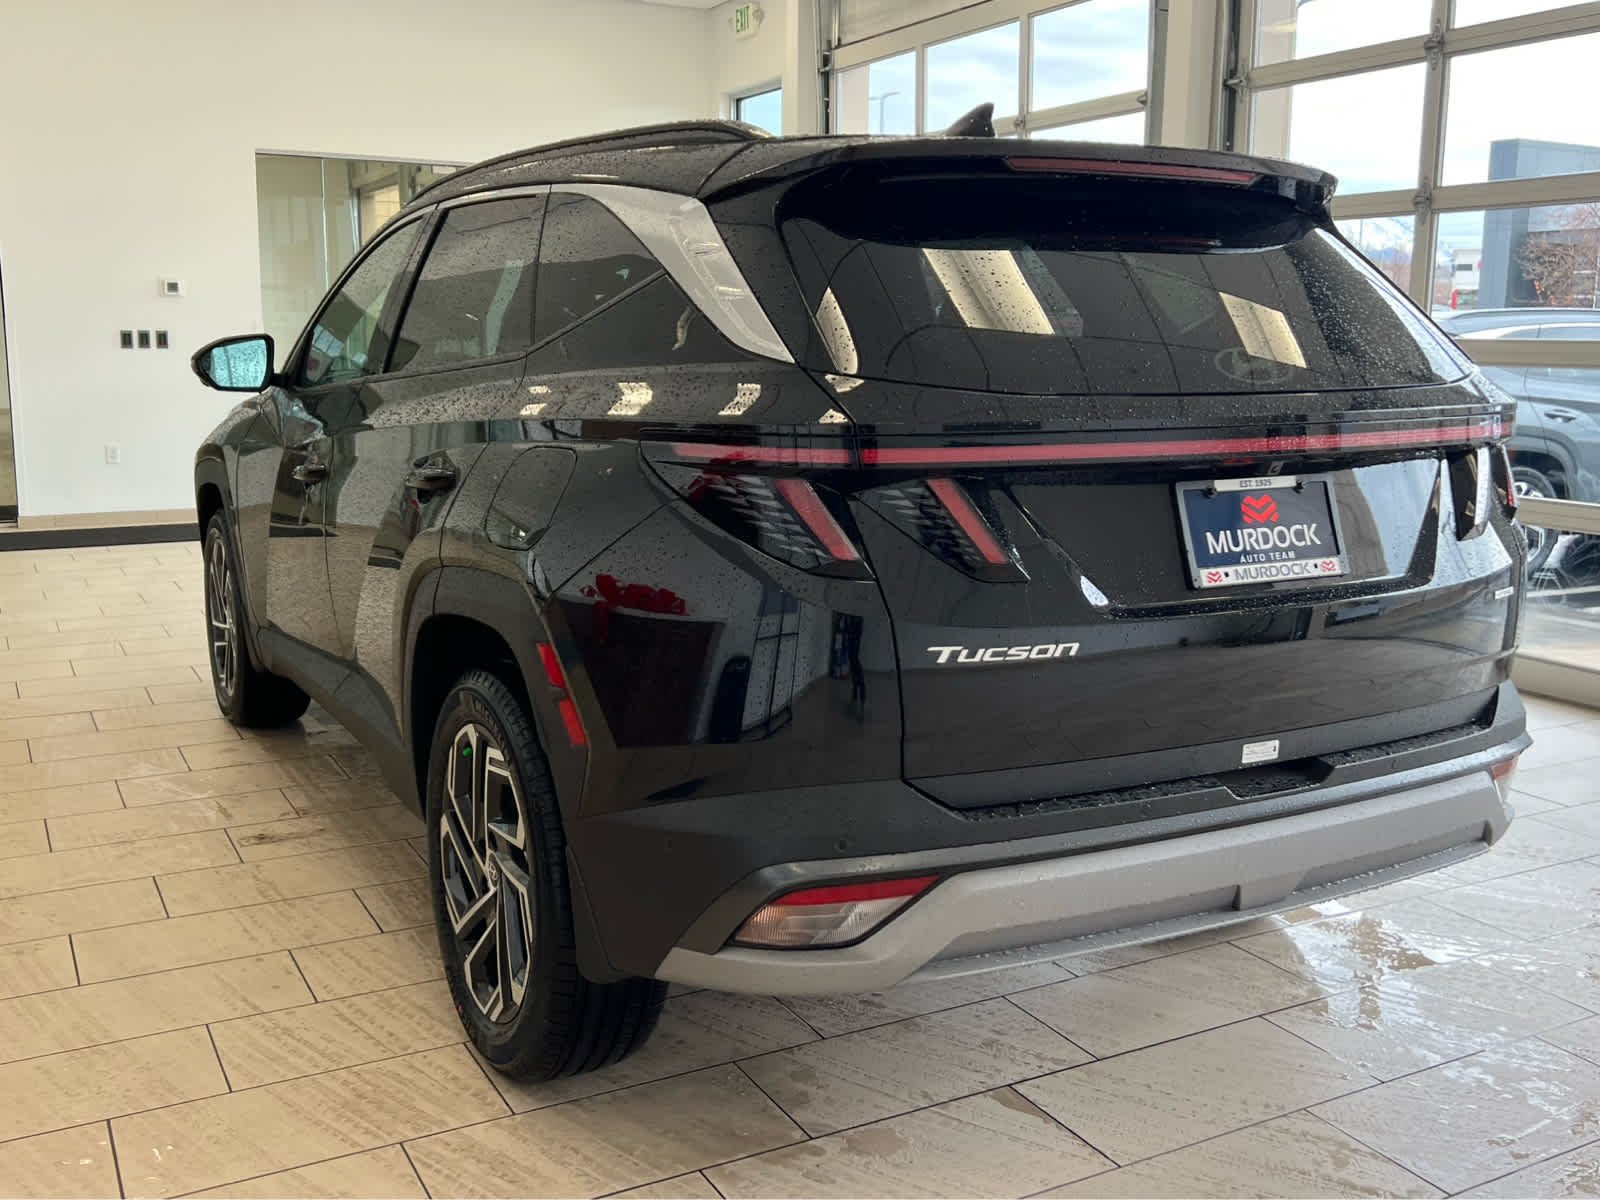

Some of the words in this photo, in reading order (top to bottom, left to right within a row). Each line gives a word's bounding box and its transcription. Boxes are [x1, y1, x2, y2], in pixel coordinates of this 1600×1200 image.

[735, 6, 750, 32] EXIT
[1206, 523, 1321, 554] MURDOCK
[1240, 553, 1265, 563] AUTO
[1268, 550, 1296, 561] TEAM
[1235, 562, 1311, 581] MURDOCK
